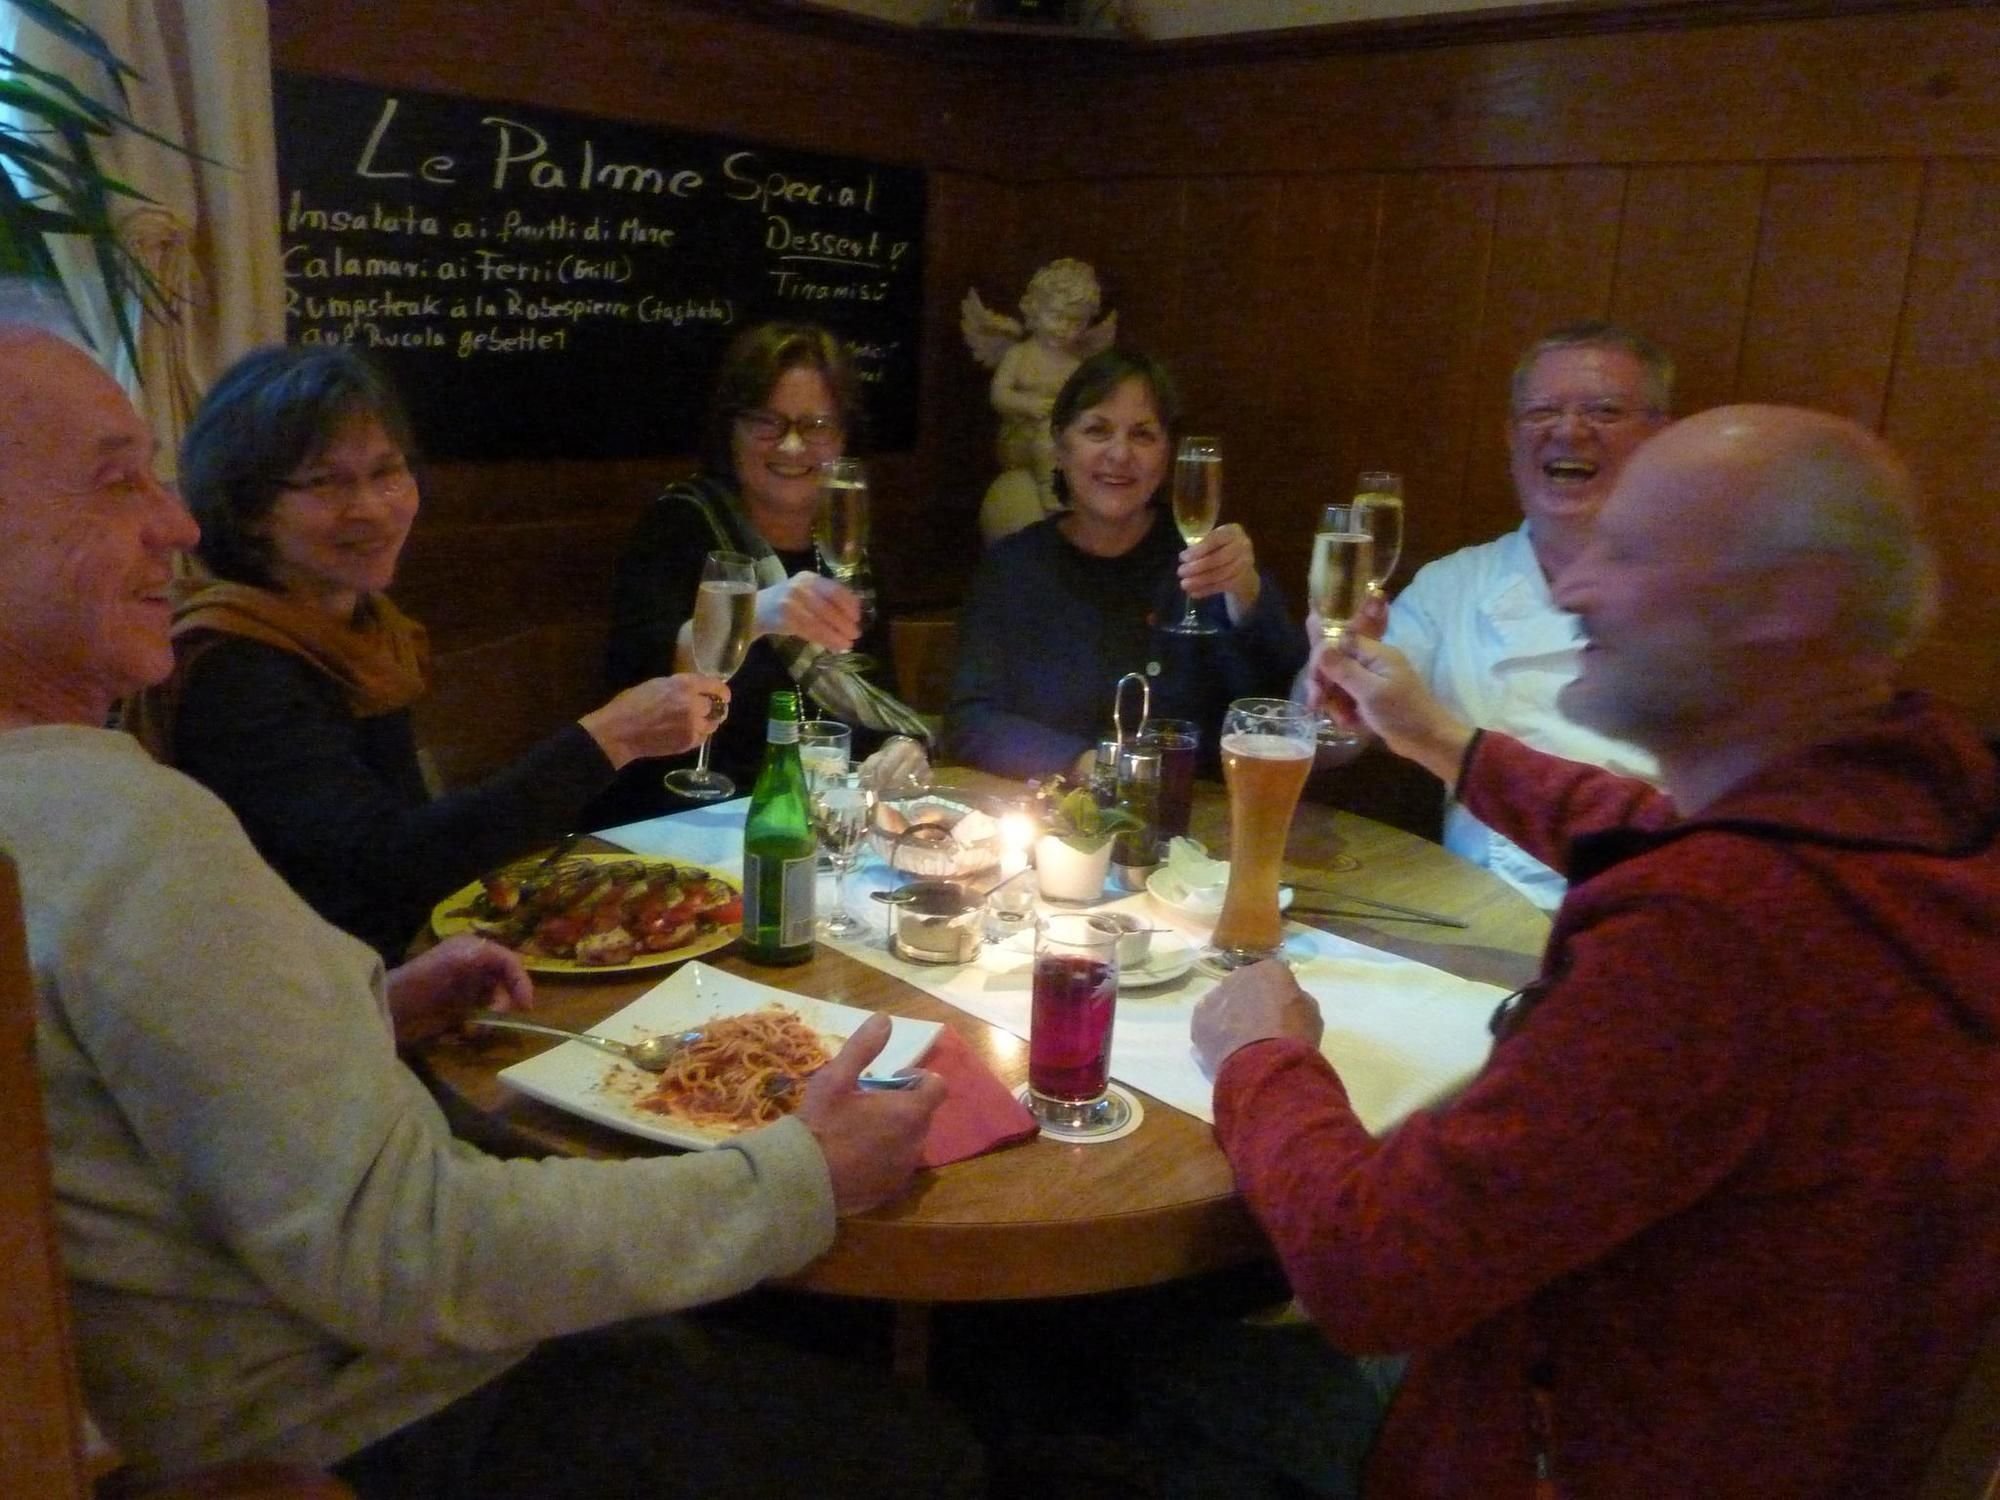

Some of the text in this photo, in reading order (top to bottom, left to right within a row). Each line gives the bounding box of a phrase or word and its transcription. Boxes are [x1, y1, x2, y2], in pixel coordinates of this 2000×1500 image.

[356, 98, 873, 214] Le Palme Special
[286, 189, 440, 236] Insalata
[583, 216, 610, 241] di
[619, 216, 676, 248] Mare
[282, 244, 428, 279] Calamari
[438, 258, 468, 281] ai
[473, 249, 552, 282] Ferri
[285, 288, 441, 325] Rumpsteak
